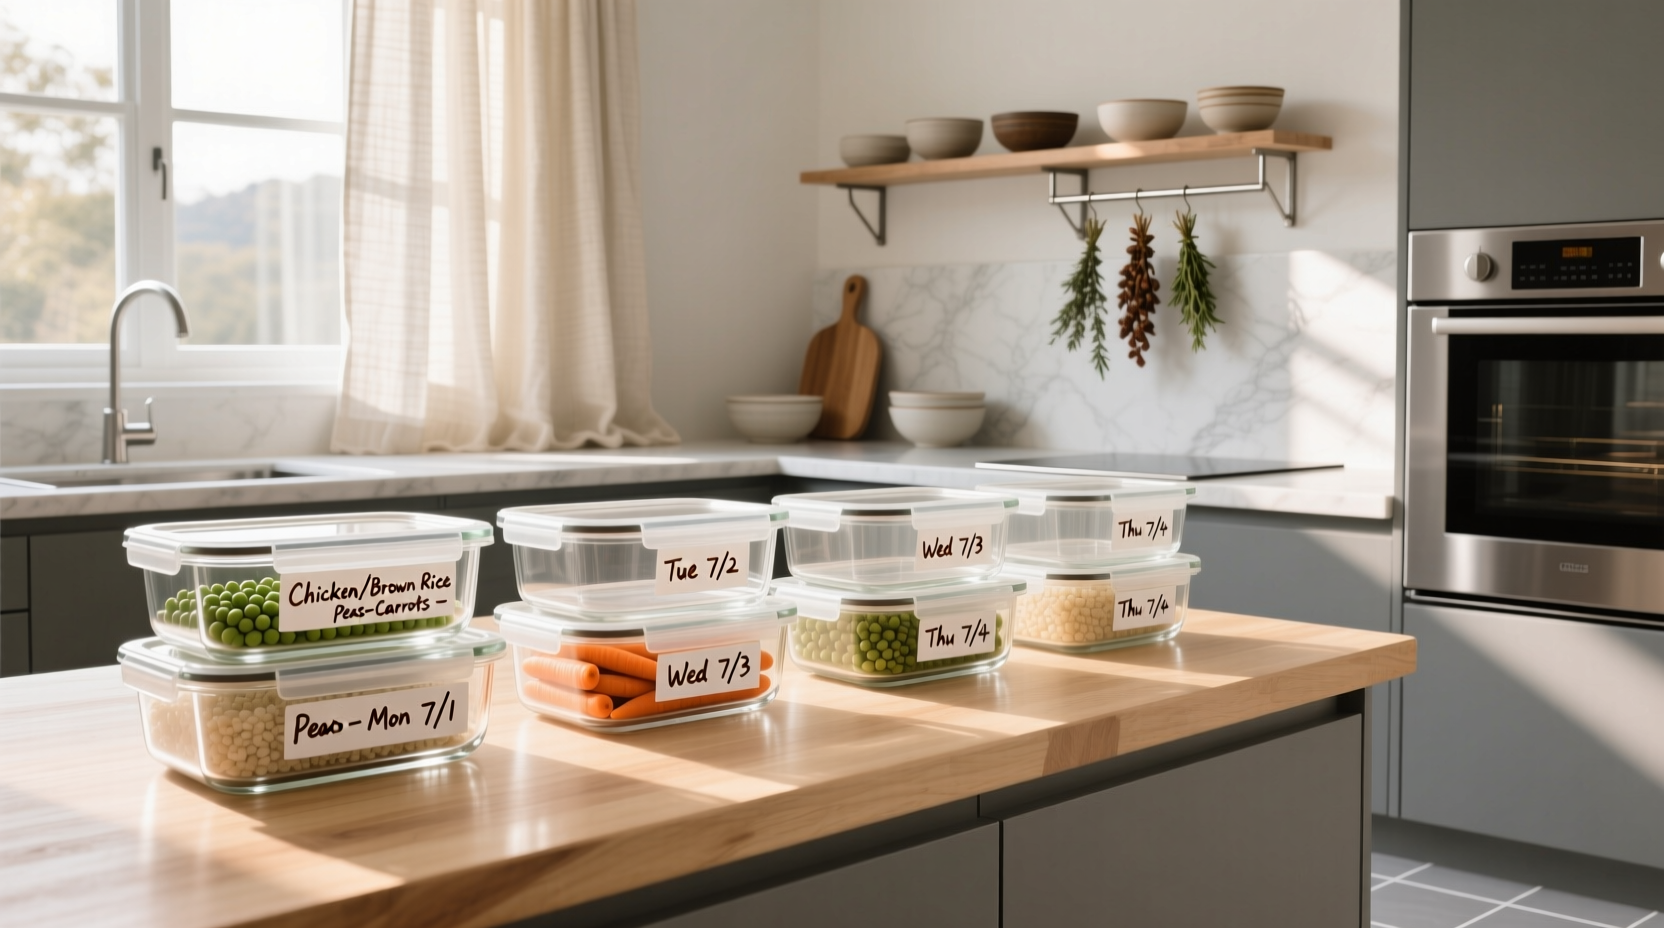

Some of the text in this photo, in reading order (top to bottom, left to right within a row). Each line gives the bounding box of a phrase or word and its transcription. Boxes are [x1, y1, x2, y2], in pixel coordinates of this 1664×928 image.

[1118, 516, 1168, 541] Thu 7/4
[923, 532, 983, 559] Wed 7/3
[664, 551, 739, 582] Tue 7/2
[289, 572, 451, 606] Chicken/Brown Rice
[1118, 594, 1169, 619] Thu 7/4
[925, 618, 990, 648] Thu 7/4
[668, 651, 751, 687] Wed 7/3
[421, 691, 455, 729] 7/1
